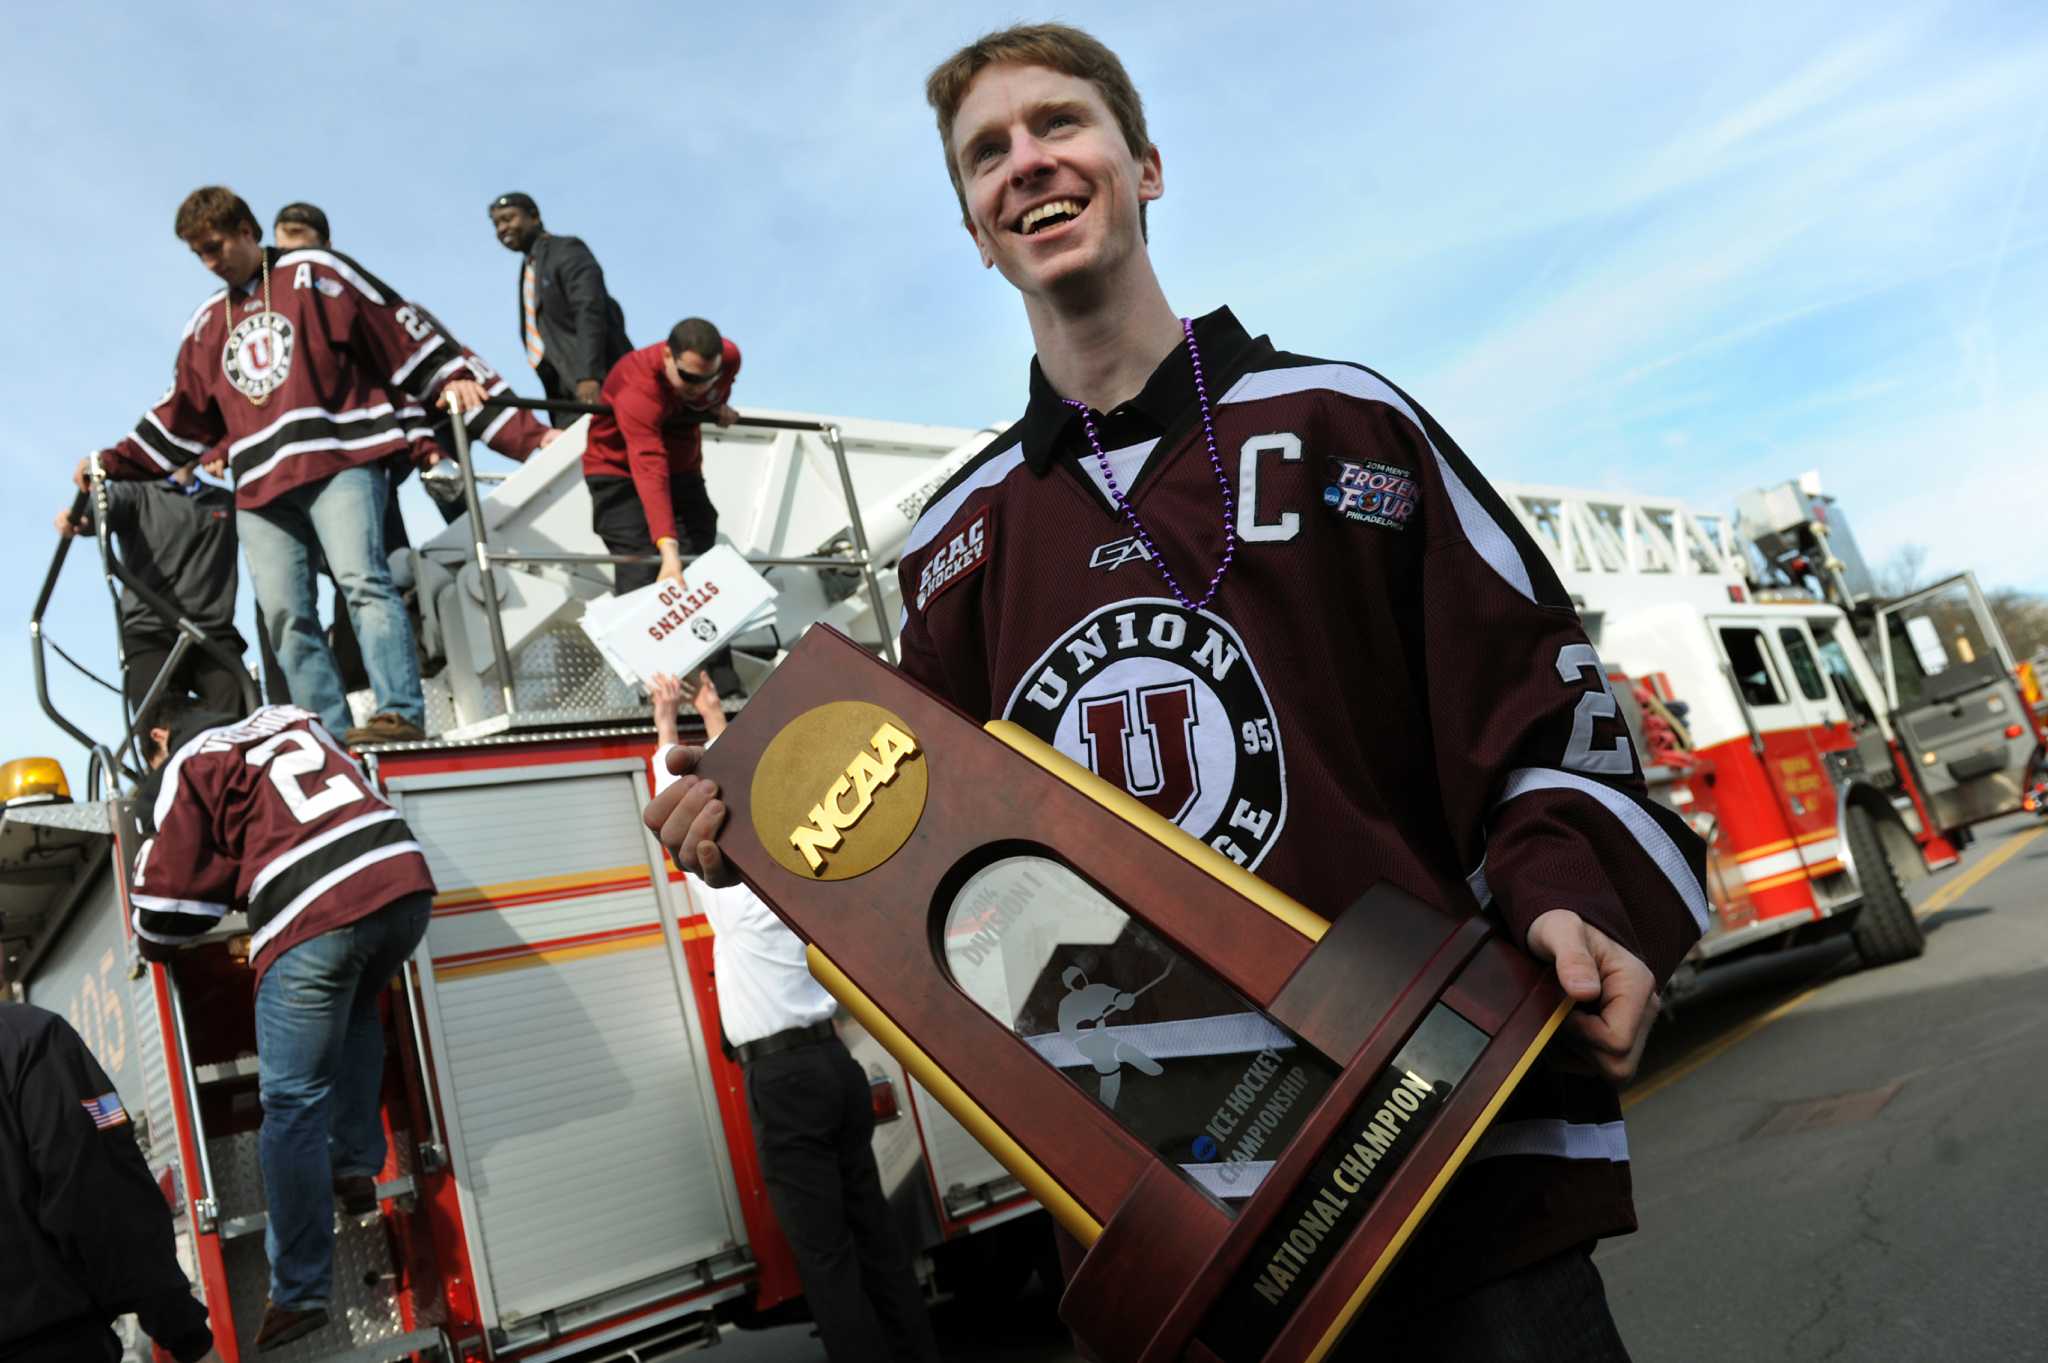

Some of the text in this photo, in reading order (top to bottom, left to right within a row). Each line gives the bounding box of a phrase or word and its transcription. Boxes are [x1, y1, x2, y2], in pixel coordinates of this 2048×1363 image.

[293, 262, 313, 290] A
[1236, 432, 1302, 542] C
[1338, 486, 1414, 521] FOUR
[1339, 462, 1418, 497] FROZEN
[658, 585, 683, 607] 30
[918, 516, 985, 592] ECAC
[926, 540, 985, 598] HOCKEY
[648, 581, 720, 641] STEVENS
[1025, 612, 1241, 711] UNION
[1078, 678, 1201, 826] U
[1241, 718, 1274, 755] 95
[1556, 643, 1634, 774] 2
[789, 721, 920, 875] NCAA
[1204, 1106, 1240, 1143] ICE
[1224, 1044, 1284, 1117] HOCKEY
[1218, 1065, 1309, 1185] CHAMPIONSHIP
[1252, 1069, 1434, 1305] NATIONAL CHAMPION
